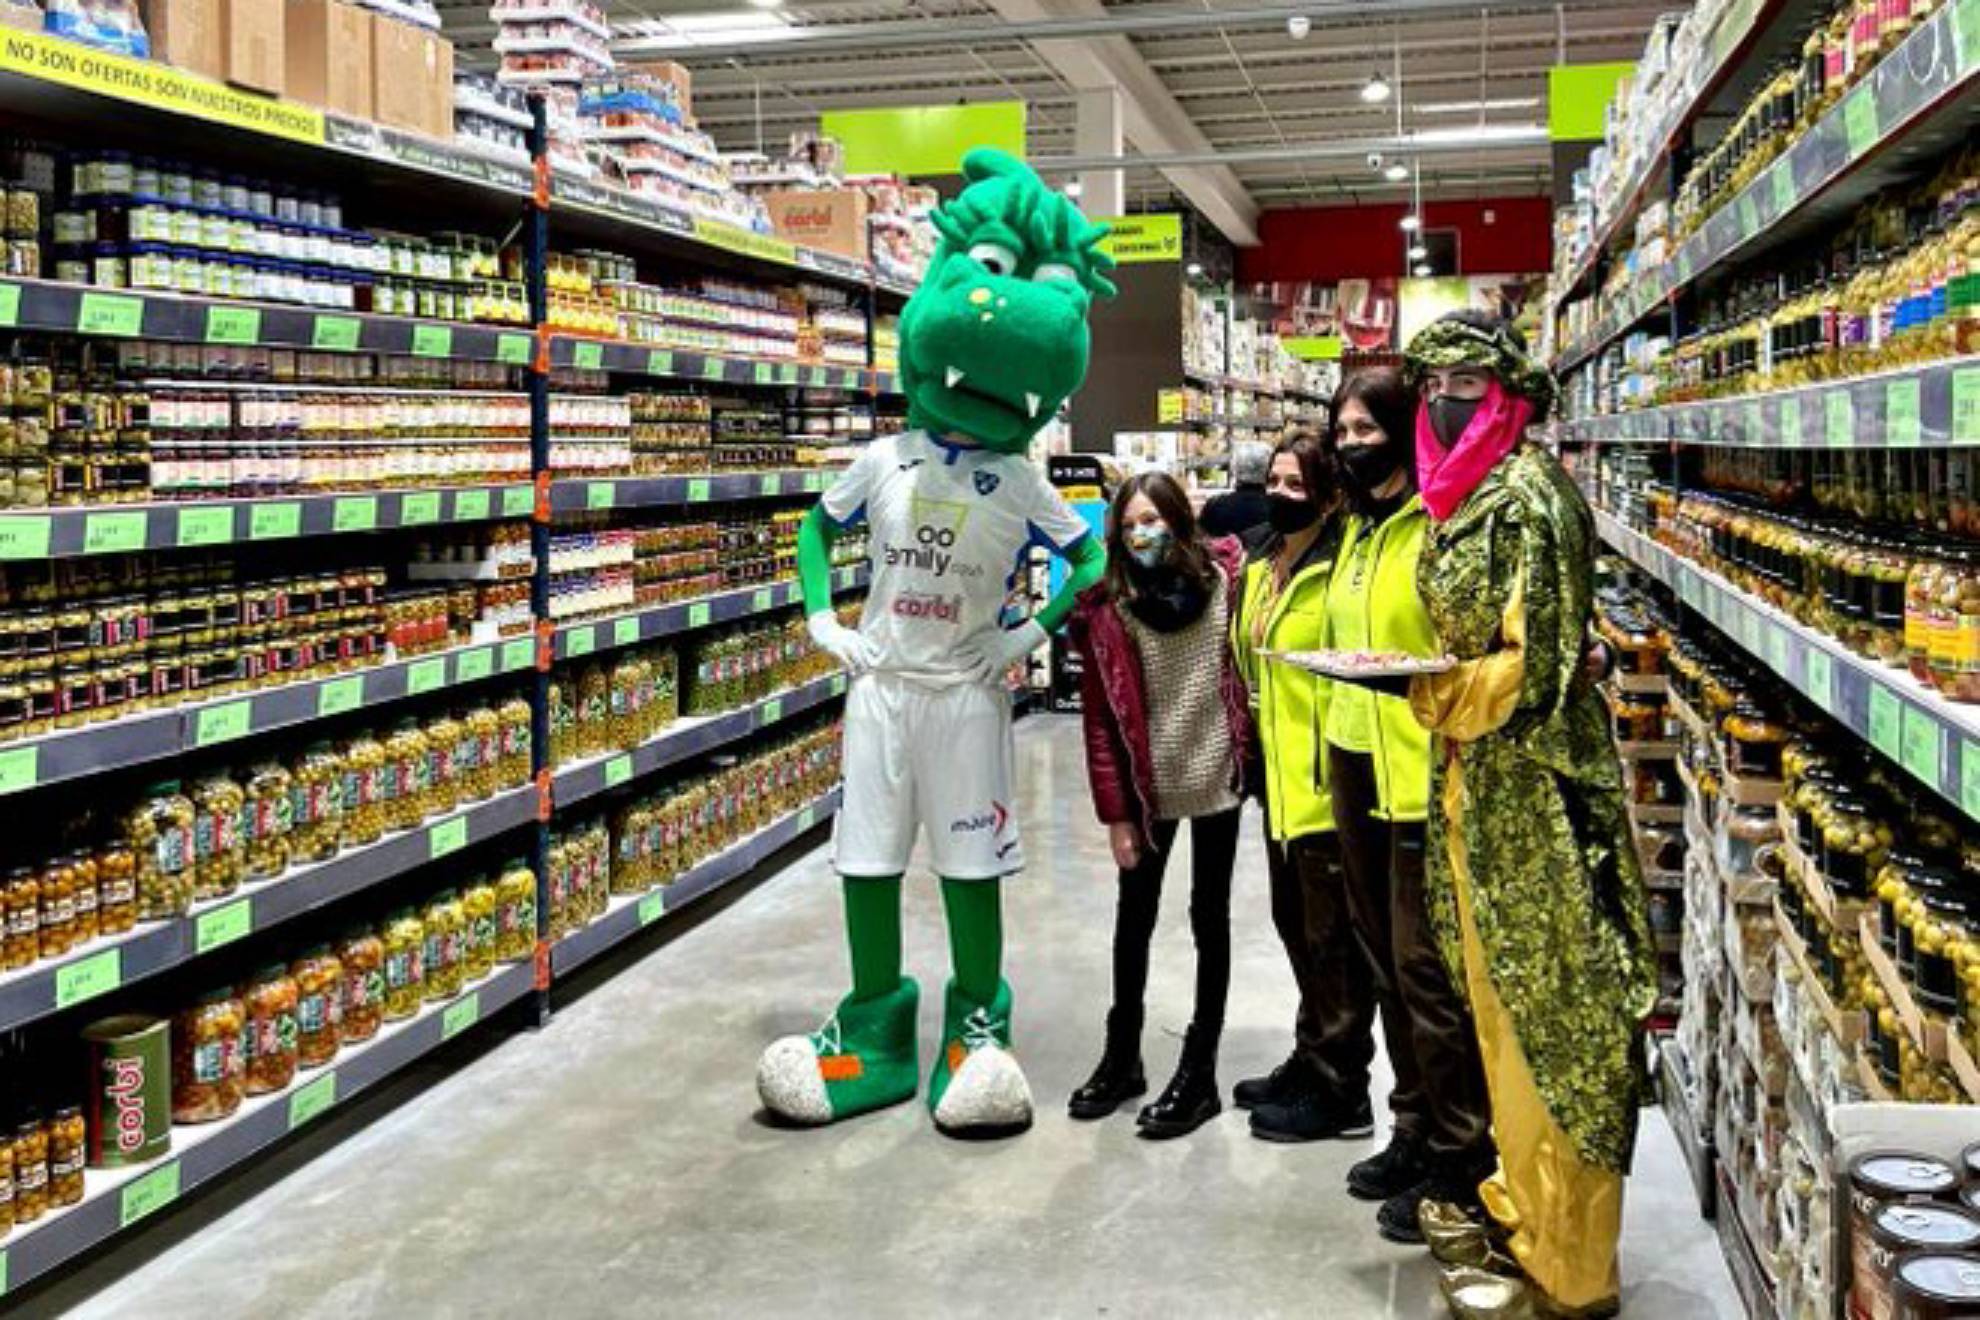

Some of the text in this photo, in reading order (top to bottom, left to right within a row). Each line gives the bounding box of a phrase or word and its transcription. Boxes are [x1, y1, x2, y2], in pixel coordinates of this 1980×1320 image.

[6, 37, 34, 62] NO
[39, 46, 76, 73] SON
[80, 58, 151, 91] OFERTAS
[154, 77, 187, 99] SON
[883, 543, 952, 577] amily
[103, 1056, 145, 1153] corbi
